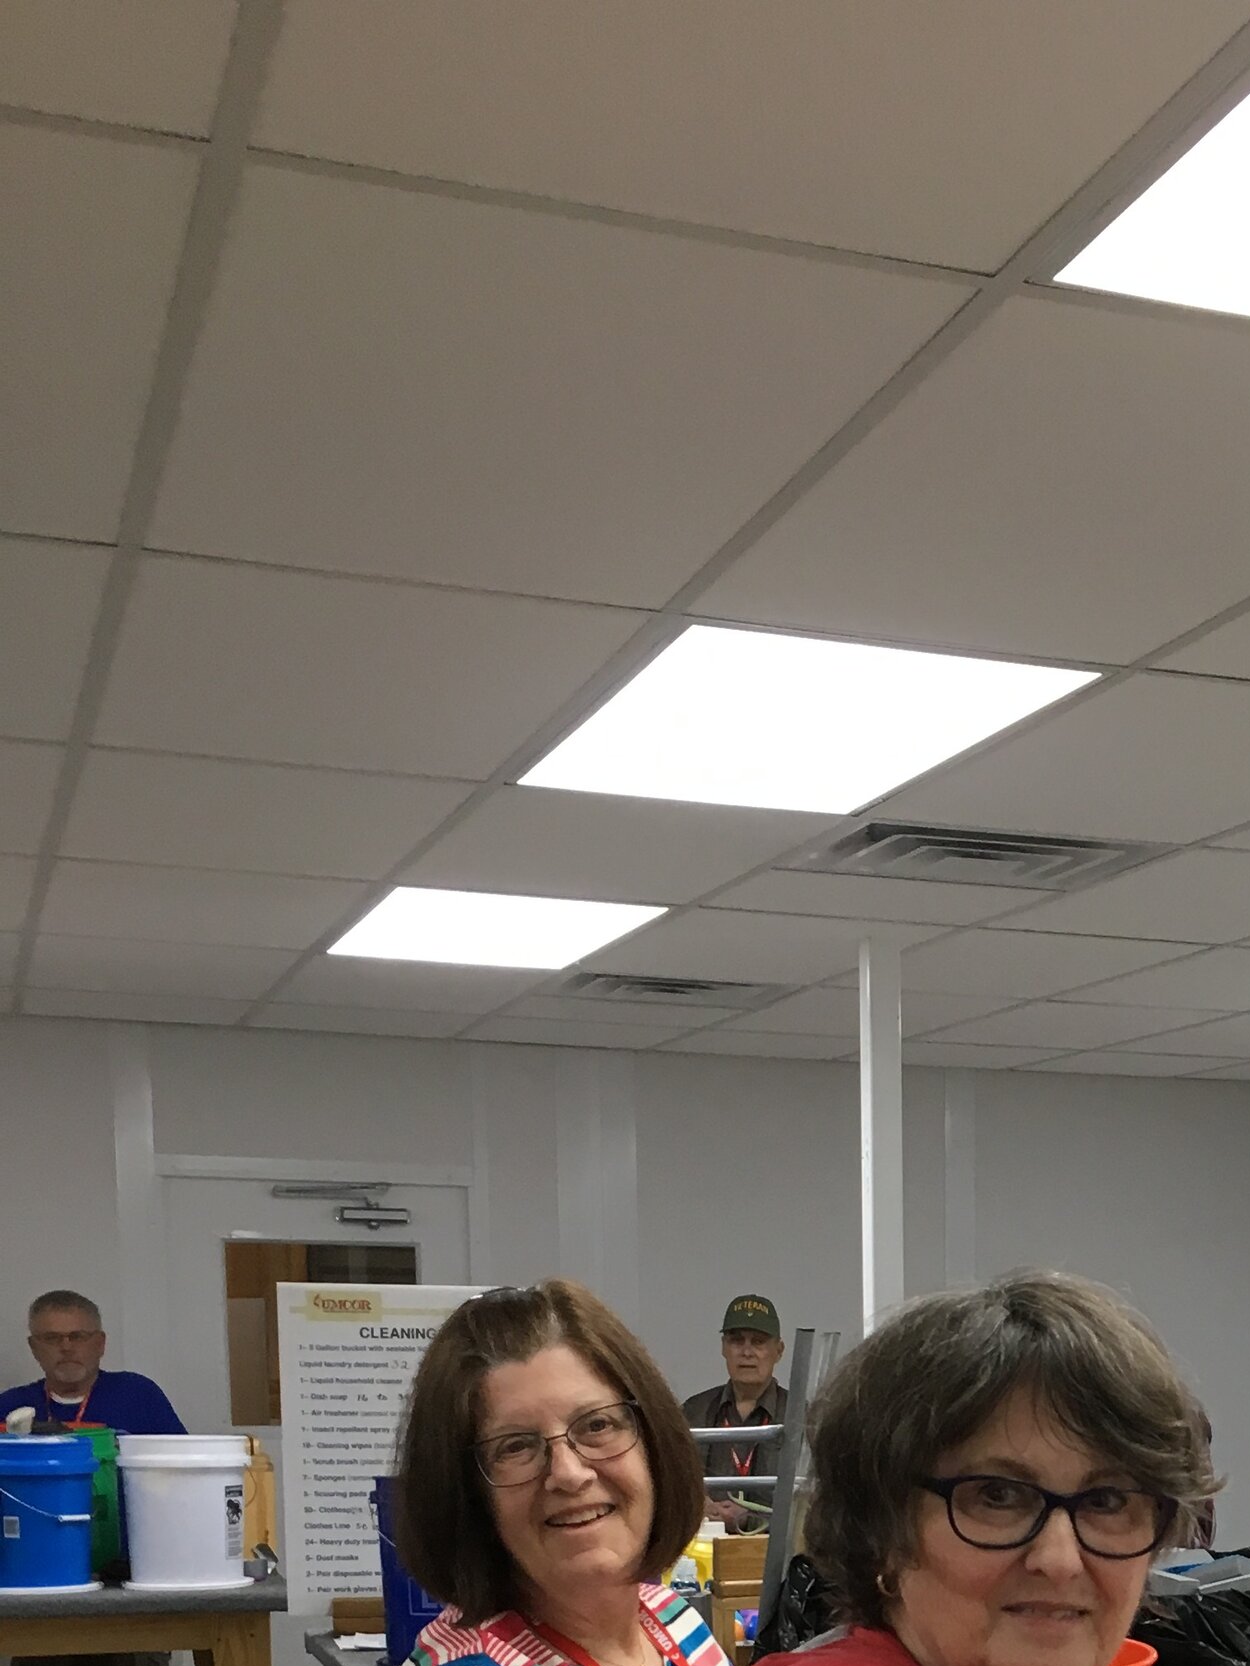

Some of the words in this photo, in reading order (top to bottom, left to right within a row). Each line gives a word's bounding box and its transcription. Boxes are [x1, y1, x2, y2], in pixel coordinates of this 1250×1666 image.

[322, 1299, 372, 1311] UMCOR
[734, 1300, 769, 1315] VETERAN
[359, 1327, 438, 1340] CLEANING
